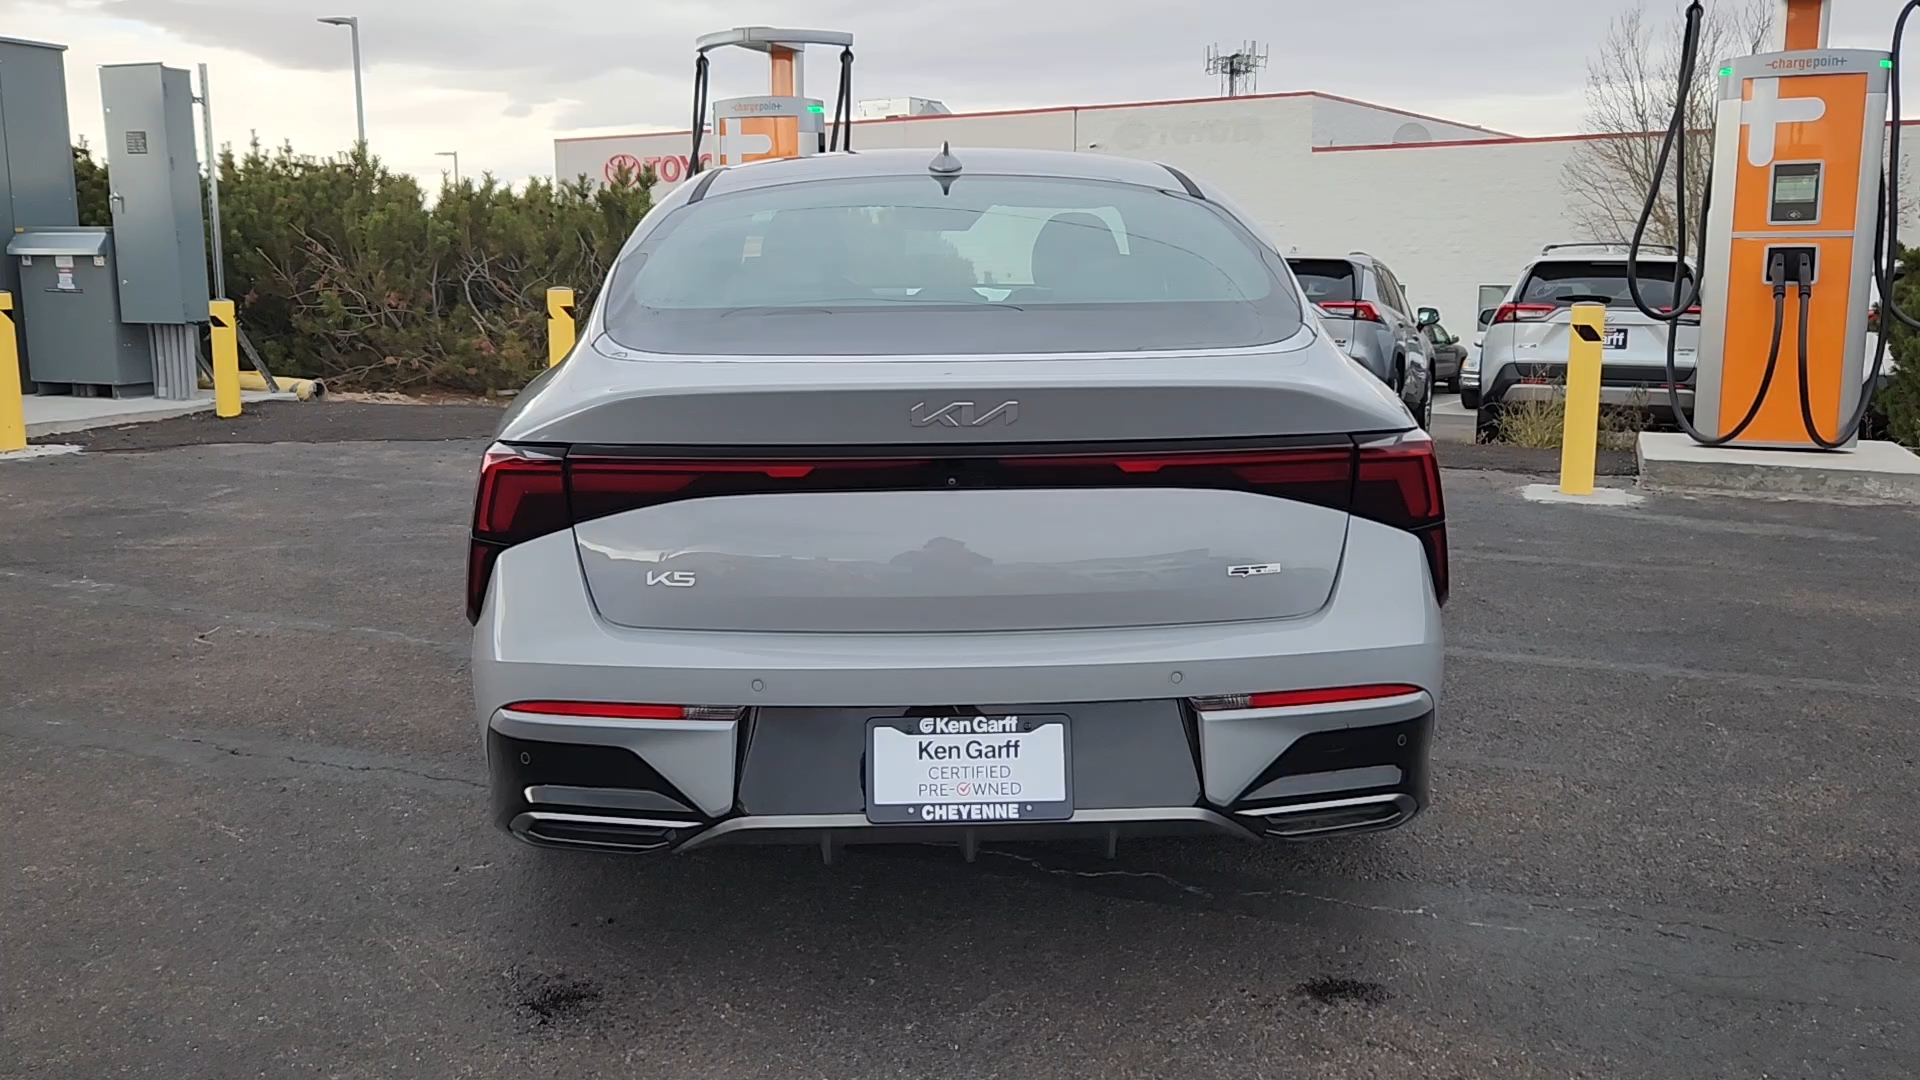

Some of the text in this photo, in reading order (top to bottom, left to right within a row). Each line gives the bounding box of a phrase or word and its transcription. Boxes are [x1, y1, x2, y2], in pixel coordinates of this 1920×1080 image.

[910, 401, 1018, 427] KIA
[646, 570, 696, 587] K5
[935, 716, 1018, 733] Ken Garff
[918, 740, 1020, 760] Ken Garff
[928, 765, 1011, 780] CERTIFIED
[921, 804, 1020, 820] CHEYENNE
